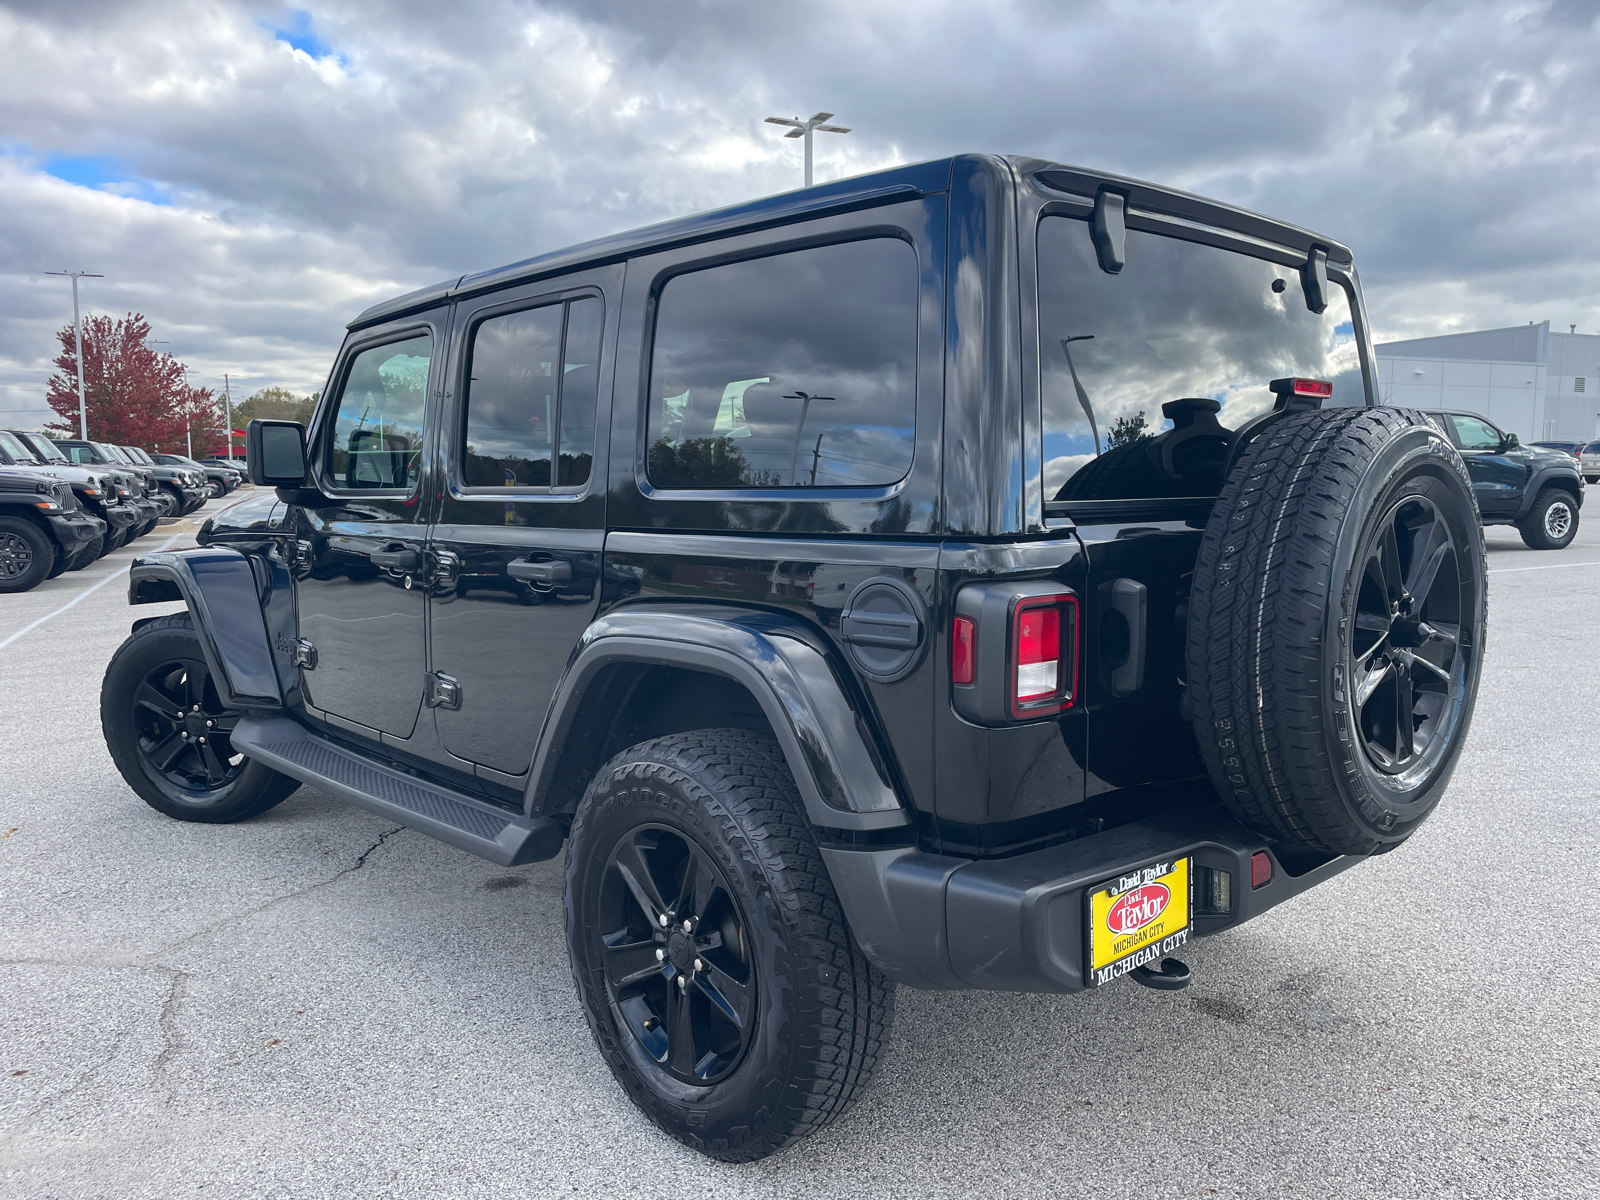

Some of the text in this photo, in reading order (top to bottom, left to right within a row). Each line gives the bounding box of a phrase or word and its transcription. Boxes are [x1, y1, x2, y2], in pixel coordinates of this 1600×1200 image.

[882, 627, 905, 635] FUEL
[602, 787, 756, 915] BRIDGESTONE
[1119, 863, 1168, 893] David Taylor
[1117, 895, 1164, 932] Taylor
[1124, 889, 1142, 907] David
[1113, 922, 1165, 955] MICHIGAN CITY
[1097, 928, 1189, 986] MICHIGAN CITY
